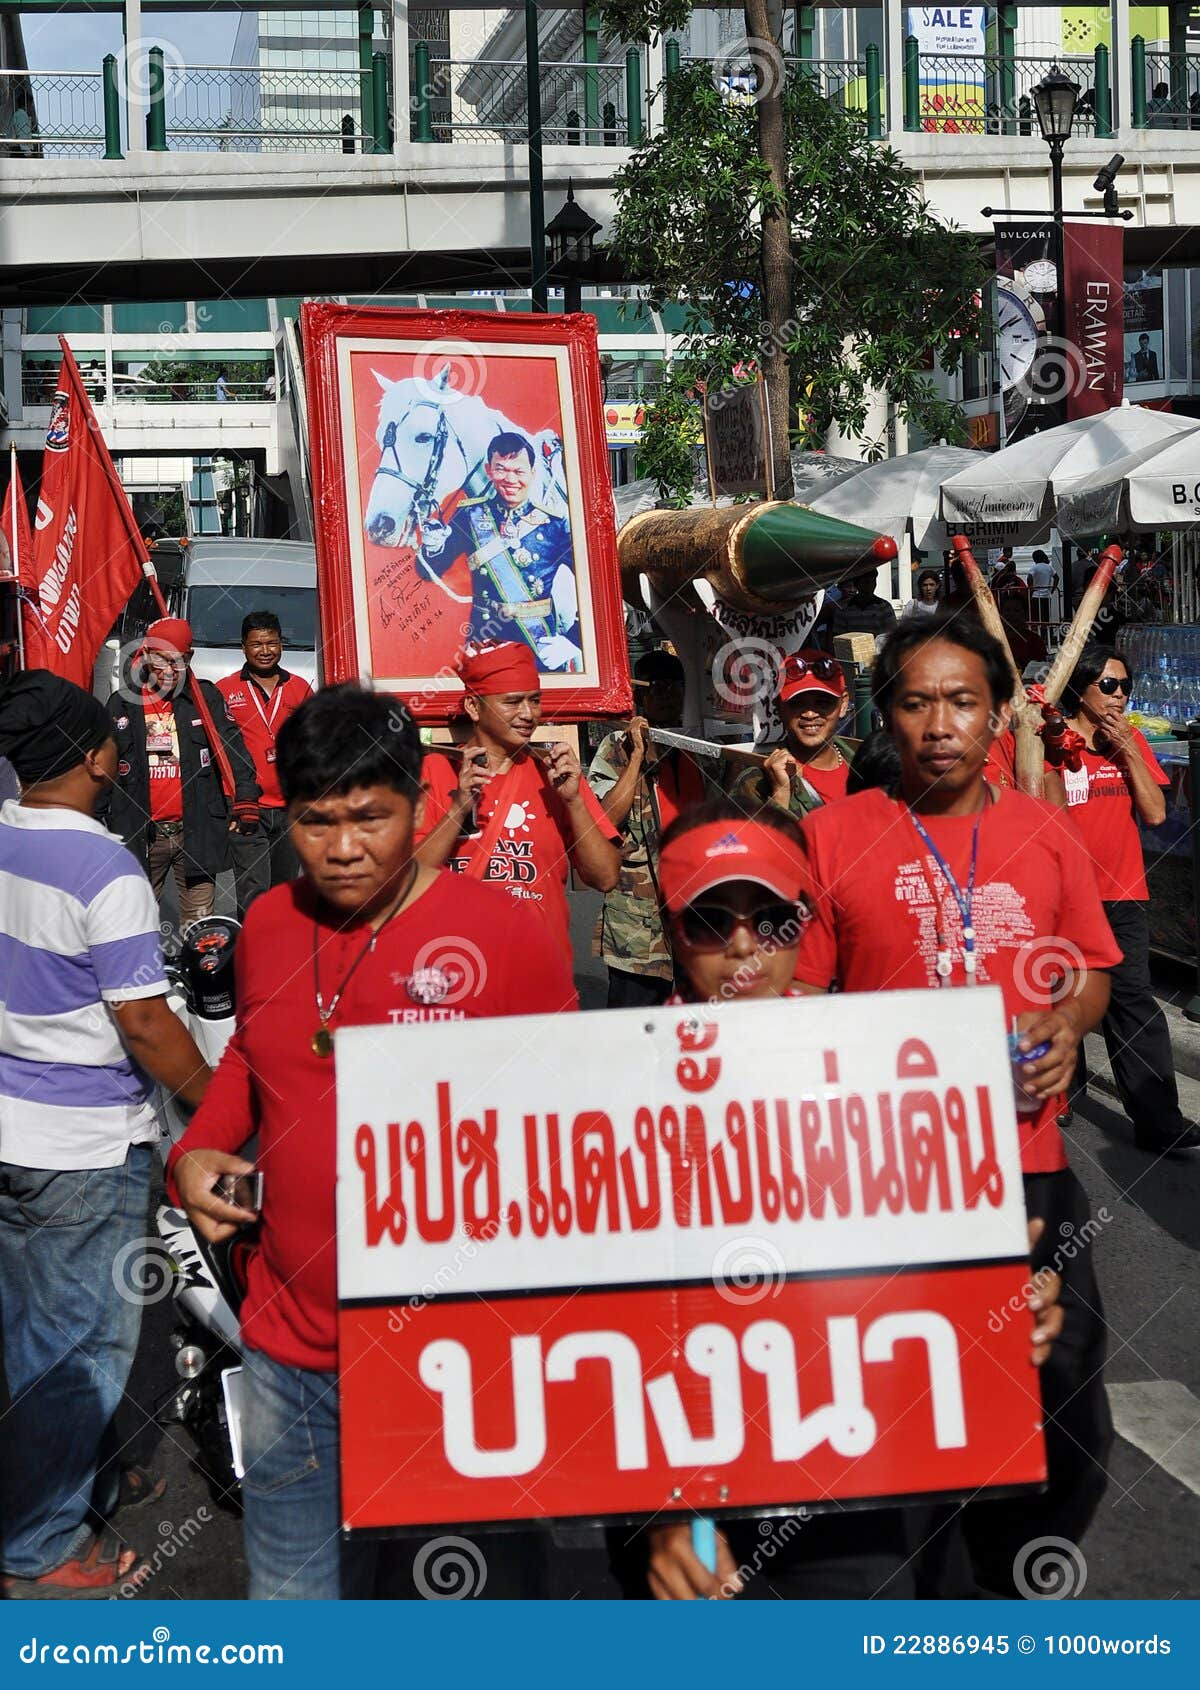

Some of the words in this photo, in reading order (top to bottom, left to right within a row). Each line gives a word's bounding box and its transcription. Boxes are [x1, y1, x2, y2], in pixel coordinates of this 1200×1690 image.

[923, 7, 973, 28] SALE
[1000, 231, 1051, 239] BVLGARI
[1082, 281, 1110, 391] ERAWAN
[388, 1008, 465, 1024] TRUTH
[355, 1020, 1004, 1248] นปช.แดงทั้งแผ่นดิน
[418, 1311, 968, 1479] บางนา
